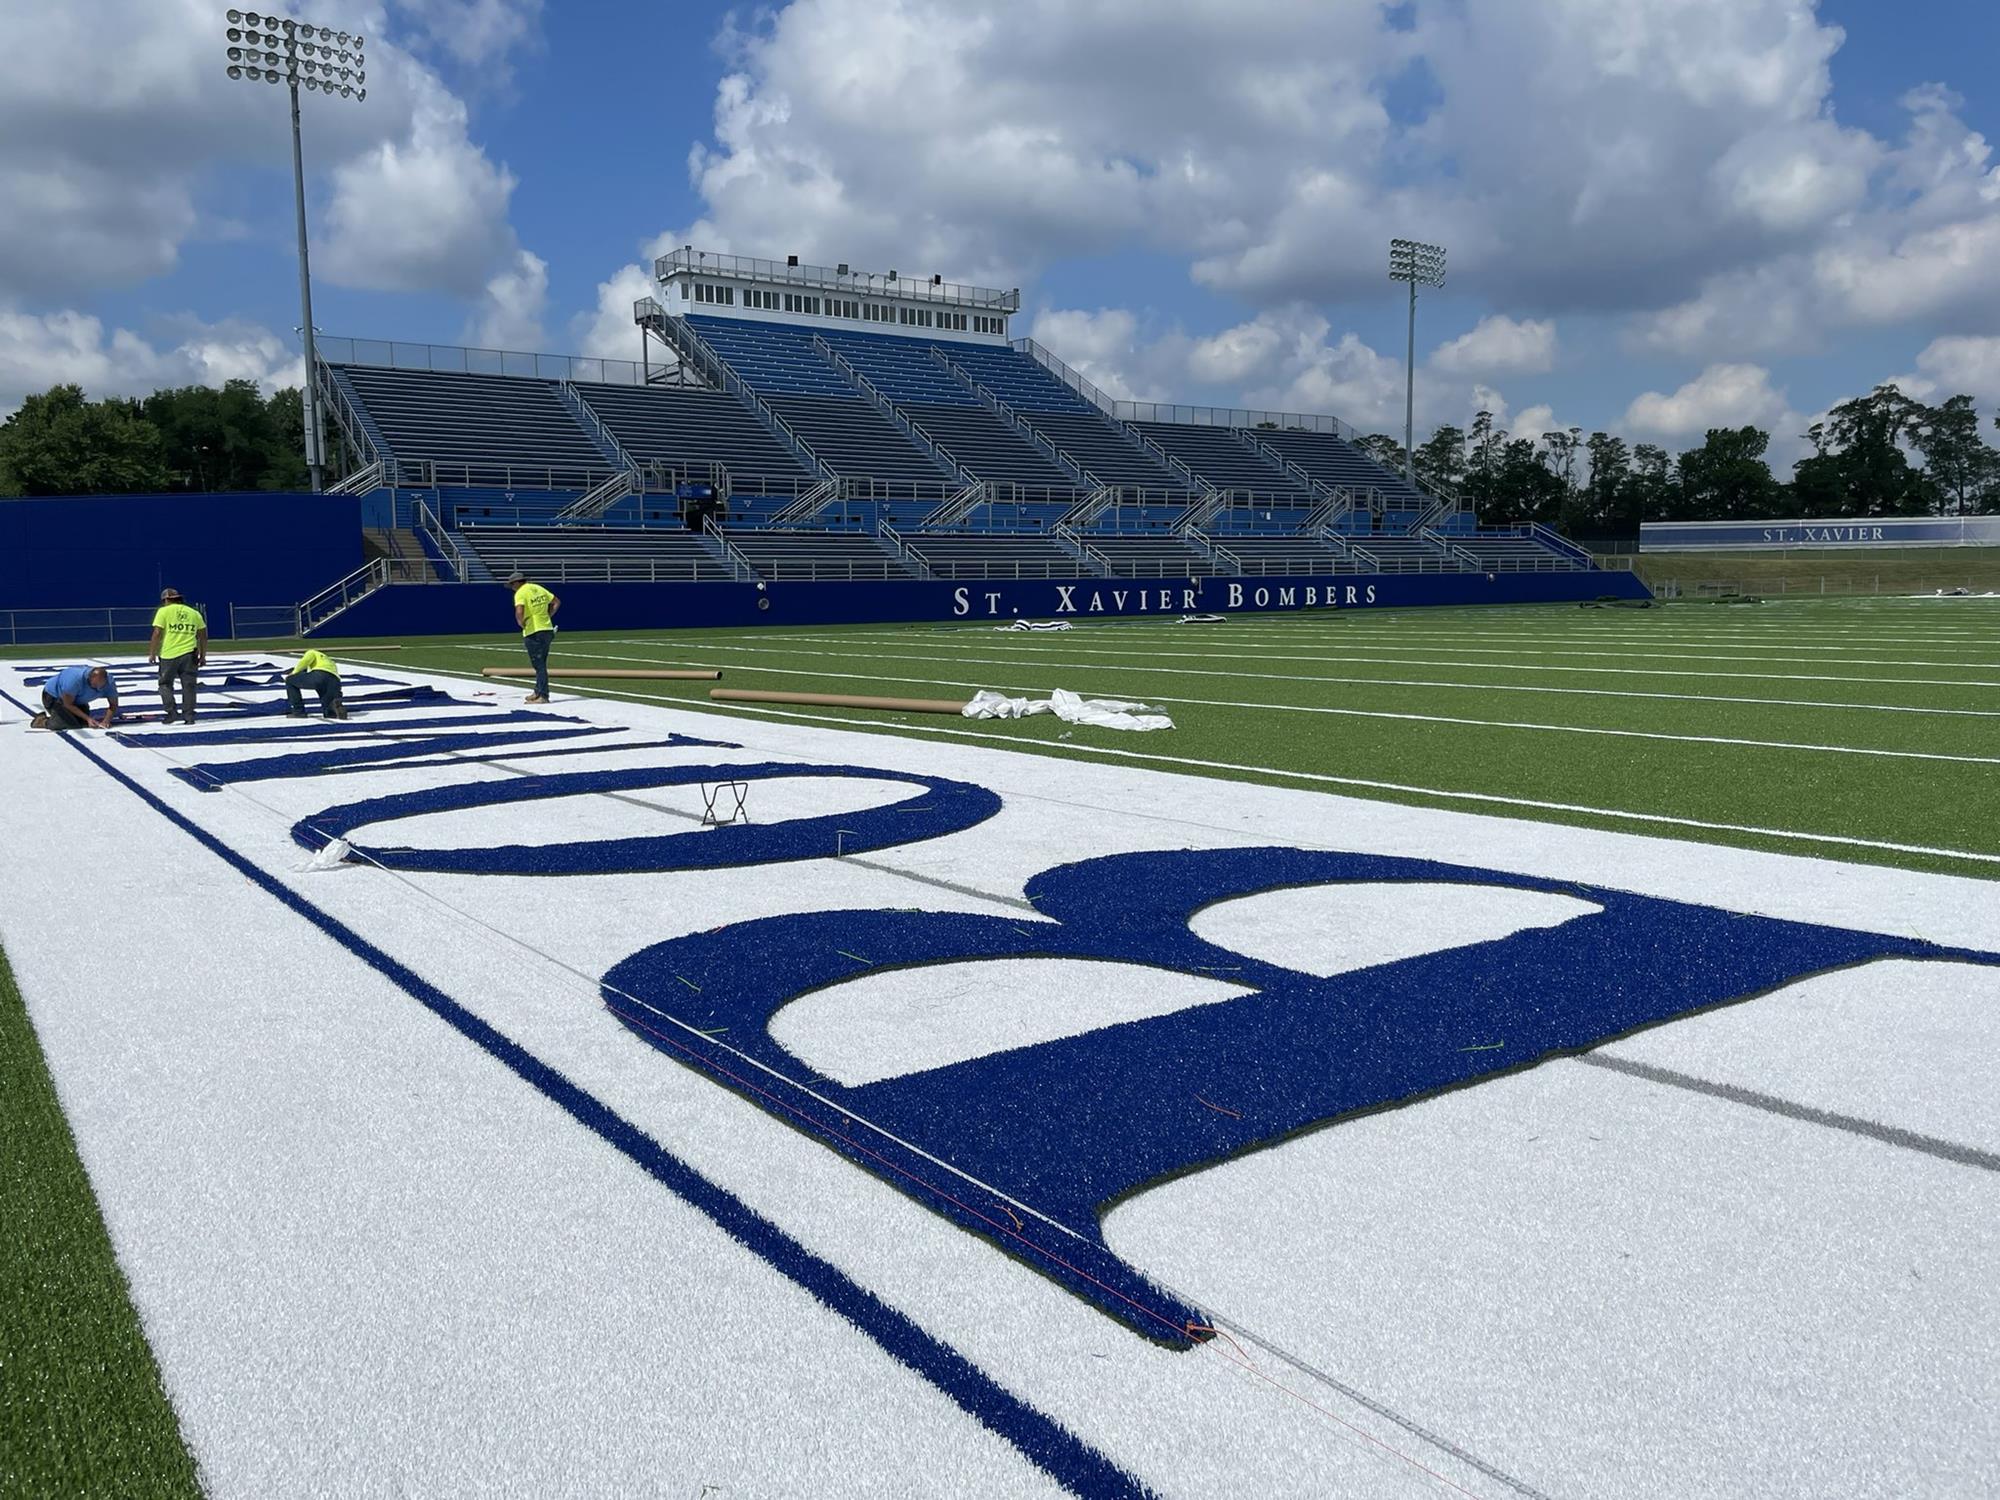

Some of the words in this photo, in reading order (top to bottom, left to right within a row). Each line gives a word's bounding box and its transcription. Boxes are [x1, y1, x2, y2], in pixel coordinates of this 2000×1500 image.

[1763, 529, 1794, 542] ST.
[1804, 527, 1883, 541] XAVIER
[953, 587, 1019, 615] ST.
[1055, 586, 1196, 612] XAVIER
[1228, 583, 1376, 608] BOMBERS
[169, 623, 196, 631] MOTZ
